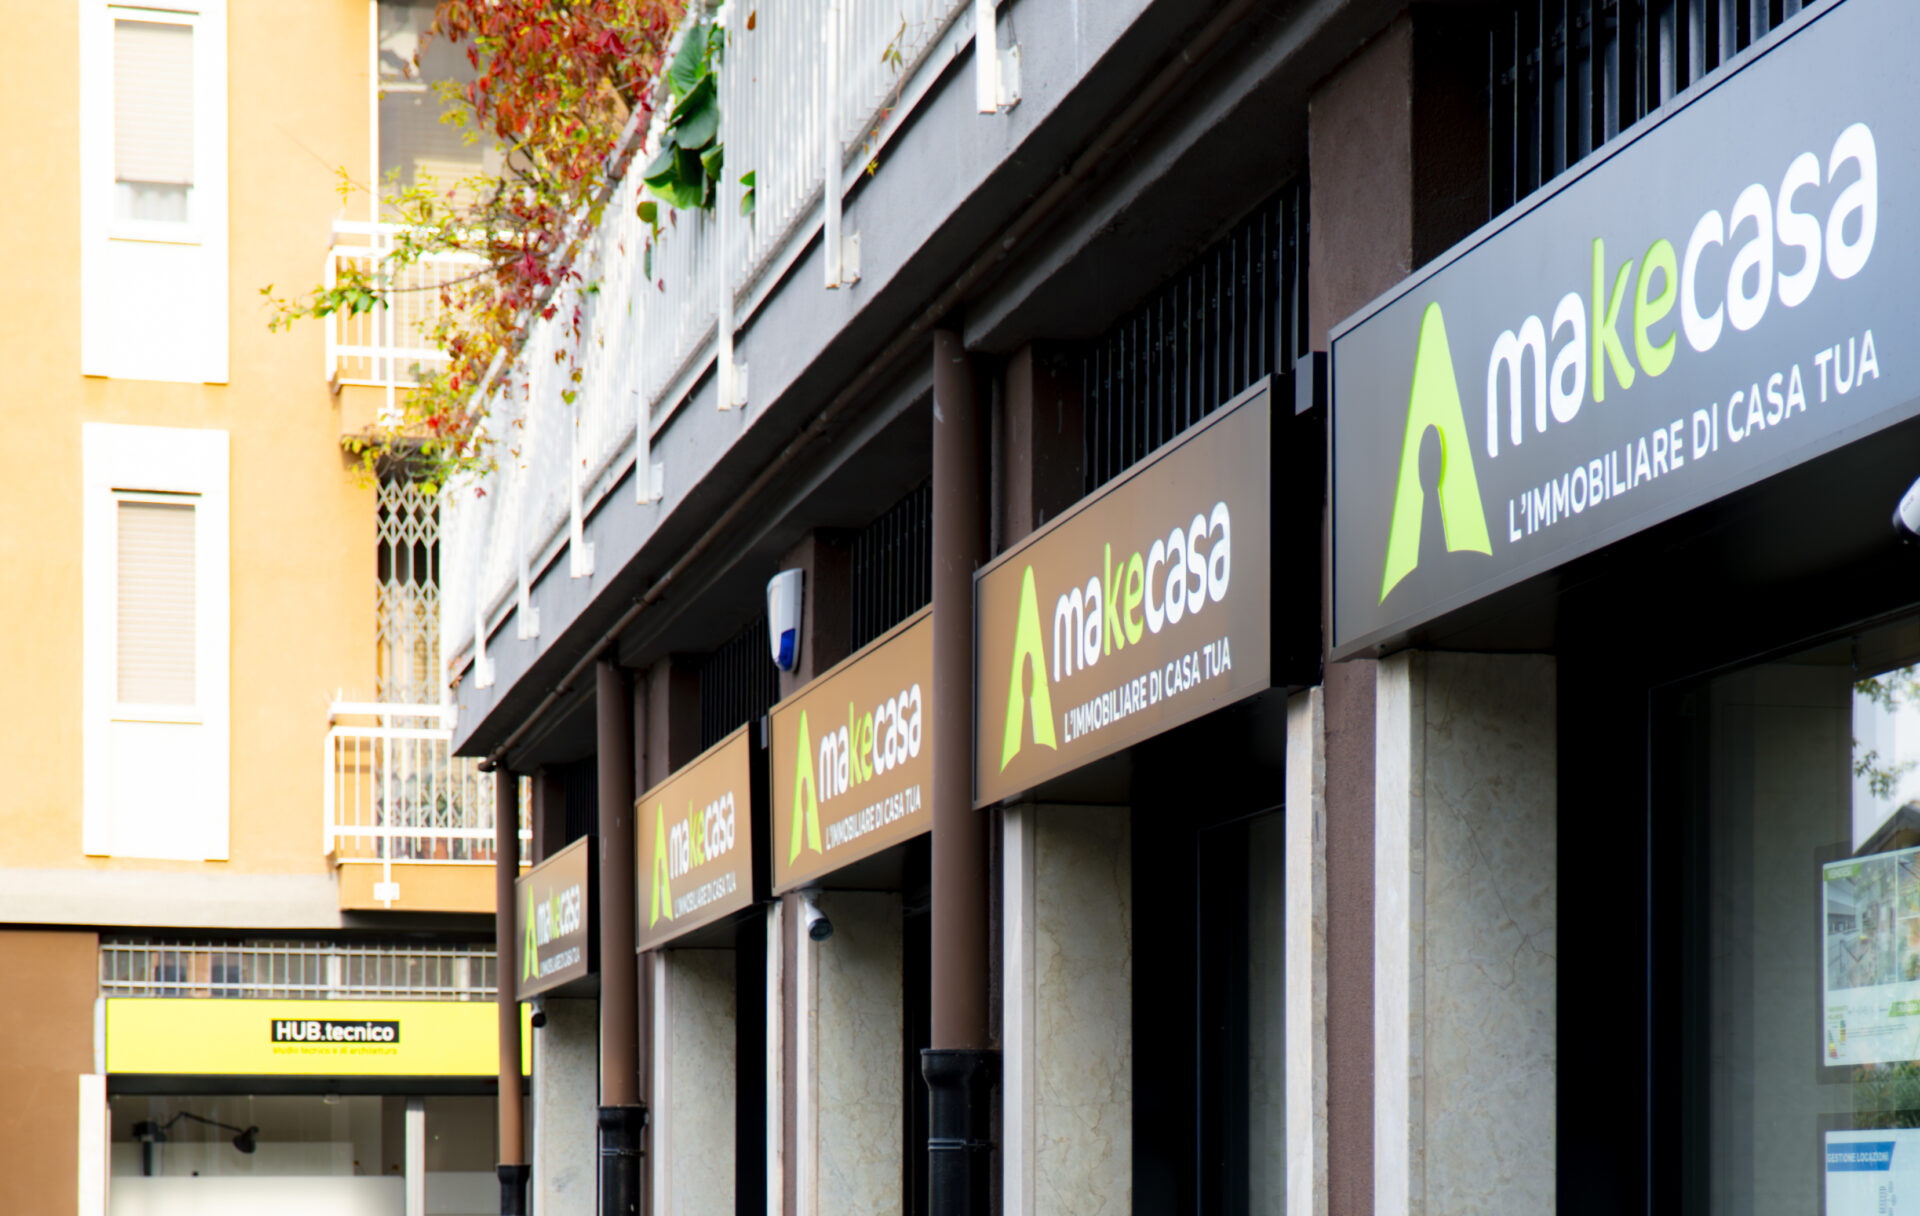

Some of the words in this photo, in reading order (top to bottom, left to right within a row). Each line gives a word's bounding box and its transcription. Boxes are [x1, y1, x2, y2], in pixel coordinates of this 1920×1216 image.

[1487, 122, 1878, 458] makecasa
[1508, 419, 1684, 543] L'IMMOBILIARE
[1693, 403, 1718, 461] DI
[1727, 364, 1806, 442] CASA
[1814, 329, 1880, 403] TUA
[1053, 501, 1231, 683] makecasa
[819, 683, 921, 803] makecasa
[1064, 675, 1147, 743] L'IMMOBILIARE
[1150, 669, 1162, 705] DI
[1165, 651, 1200, 697] CASA
[1203, 636, 1231, 680] TUA
[670, 790, 735, 881] makecasa
[884, 792, 904, 825] CASA
[905, 784, 921, 815] TUA
[276, 1020, 395, 1042] HUB.tecnico
